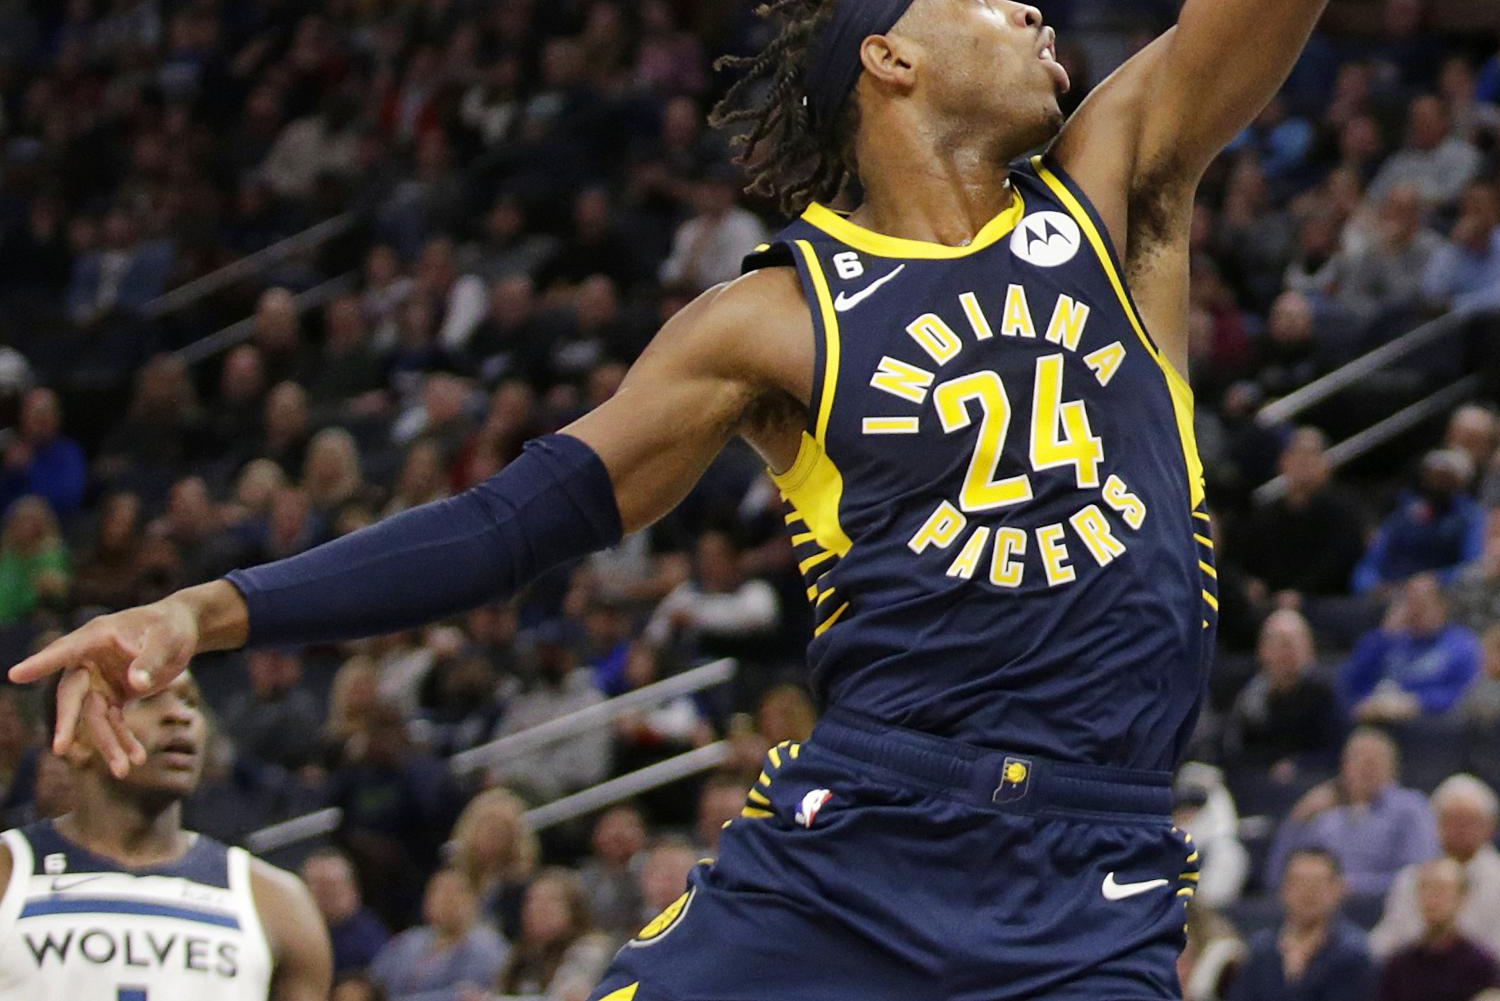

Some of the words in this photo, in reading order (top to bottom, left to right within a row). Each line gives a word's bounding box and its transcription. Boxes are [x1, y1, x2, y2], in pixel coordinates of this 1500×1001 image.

[832, 251, 865, 280] 6
[862, 283, 1127, 435] INDIANA
[932, 352, 1105, 513] 24
[906, 473, 1147, 588] PACERS
[44, 852, 67, 875] 6
[24, 929, 241, 978] WOLVES
